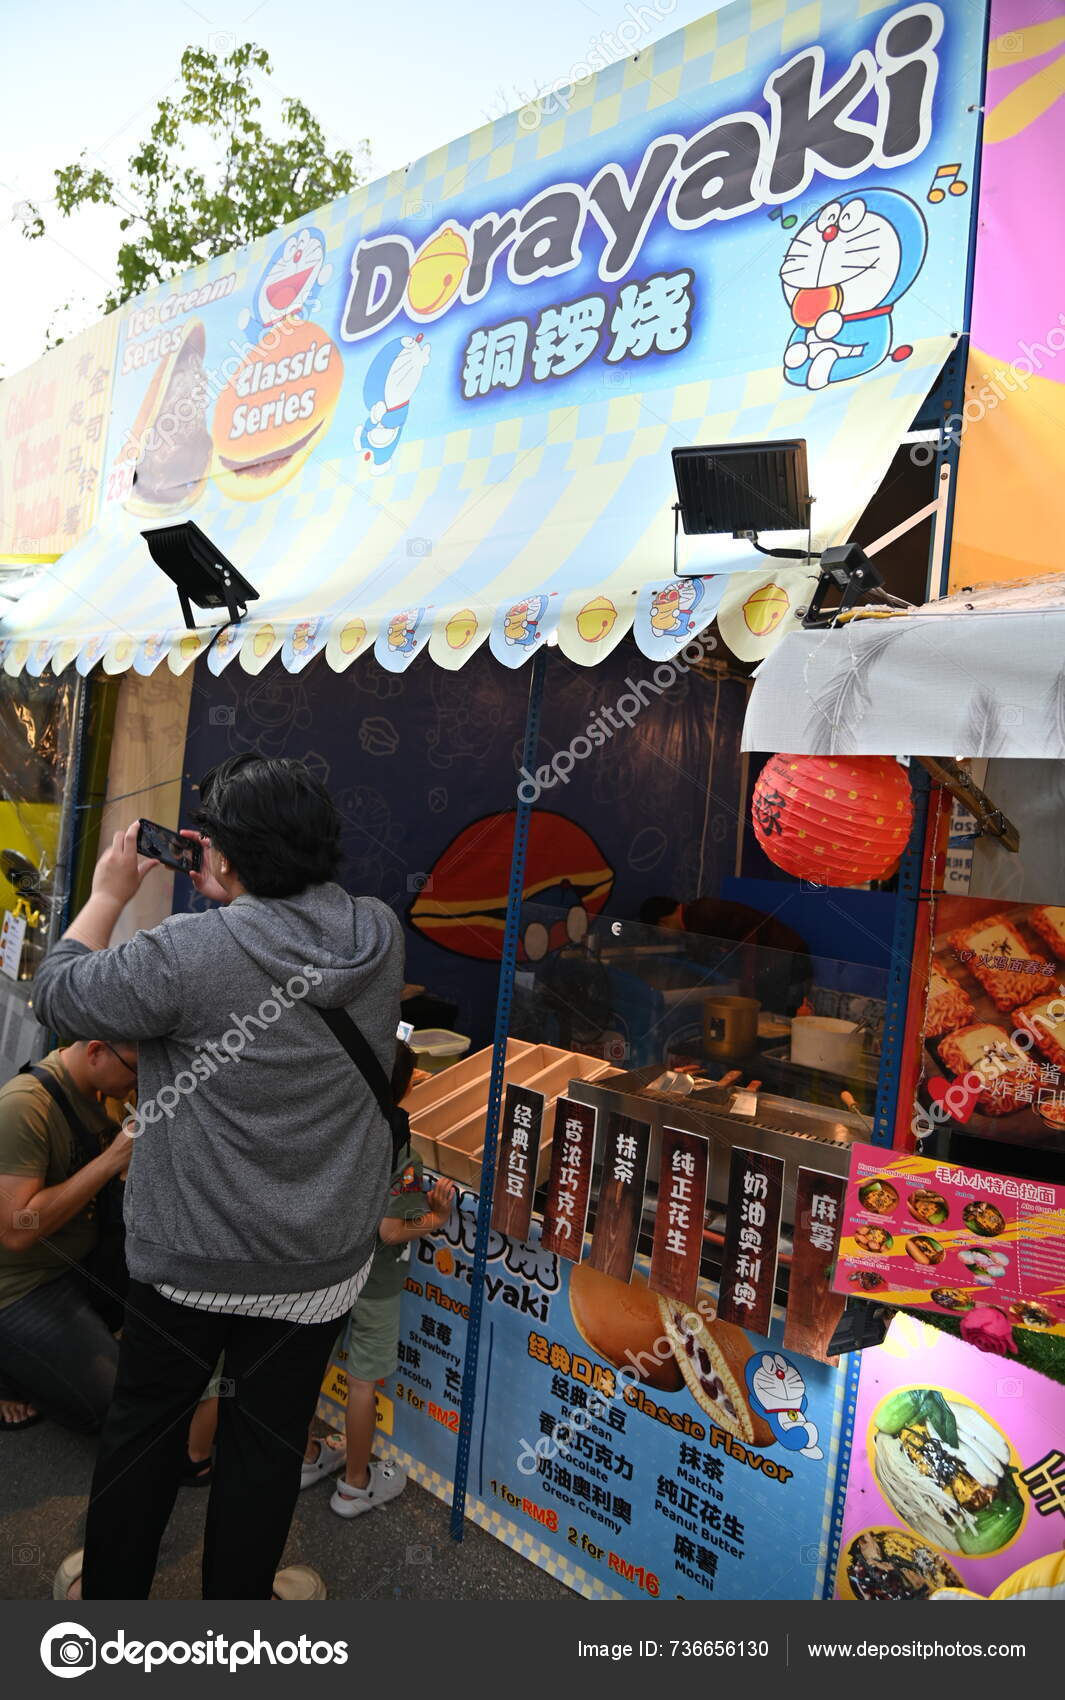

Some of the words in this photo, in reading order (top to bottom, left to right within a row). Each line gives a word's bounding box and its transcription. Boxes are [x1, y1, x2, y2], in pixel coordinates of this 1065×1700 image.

[341, 3, 945, 342] Dorayaki
[127, 306, 156, 340] Ice
[159, 272, 237, 323] Cream
[121, 325, 185, 376] Series
[462, 269, 695, 401] 铜锣烧
[235, 340, 332, 398] Classic
[228, 388, 317, 440] Series
[504, 1103, 532, 1199] 经典红豆
[613, 1133, 638, 1185] 抹茶
[553, 1118, 583, 1241] 香浓巧克力
[664, 1150, 696, 1257] 纯正花生
[935, 1165, 1056, 1206] 毛小小特色拉面
[732, 1170, 769, 1311] 奶油奥利奥
[810, 1194, 837, 1252] 麻薯
[426, 1282, 471, 1321] Flavo
[409, 1331, 461, 1366] Strewberry
[420, 1314, 453, 1346] 草莓
[396, 1383, 405, 1400] 3
[407, 1388, 425, 1410] for
[428, 1401, 460, 1434] RM2
[445, 1367, 464, 1394] 芒
[528, 1332, 616, 1398] 经典口味
[623, 1384, 706, 1440] Classic
[709, 1424, 793, 1484] Flavor
[539, 1410, 634, 1481] 香浓巧克力
[558, 1448, 608, 1484] Cocolate
[679, 1442, 725, 1485] 抹茶
[536, 1456, 632, 1525] 奶油奥利奥
[542, 1481, 576, 1507] Oreos
[578, 1502, 622, 1535] Creamy
[657, 1475, 745, 1545] 纯正花生
[676, 1466, 724, 1502] Matcha
[490, 1480, 498, 1495] 1
[567, 1527, 579, 1547] 2
[580, 1533, 605, 1561] for
[607, 1551, 661, 1598] RM16
[654, 1499, 698, 1536] Peanut
[701, 1528, 745, 1560] Butter
[673, 1533, 719, 1578] 麻薯
[674, 1559, 714, 1592] Mochi
